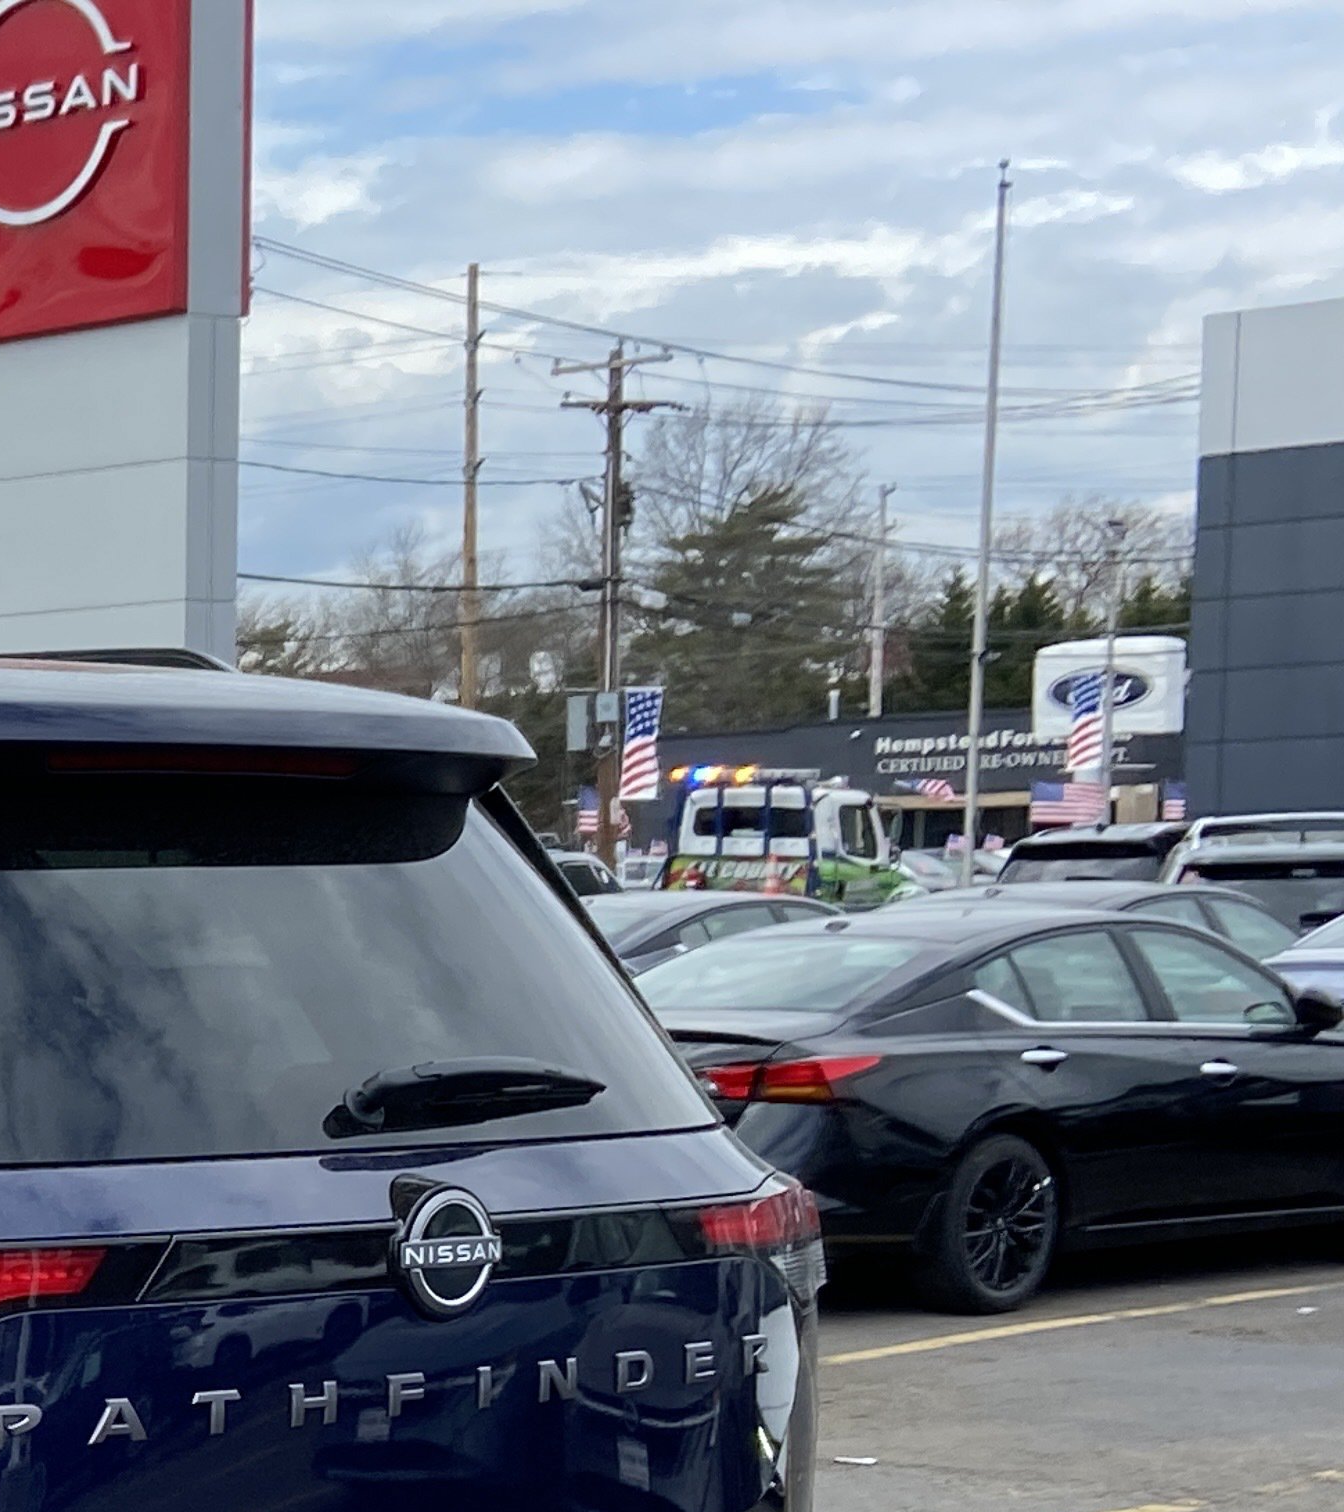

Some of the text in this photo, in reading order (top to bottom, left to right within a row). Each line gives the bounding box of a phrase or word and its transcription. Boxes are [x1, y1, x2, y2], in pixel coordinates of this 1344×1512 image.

[876, 749, 1068, 774] CERTIFIED RE-OWNE
[404, 1241, 501, 1265] NISSAN
